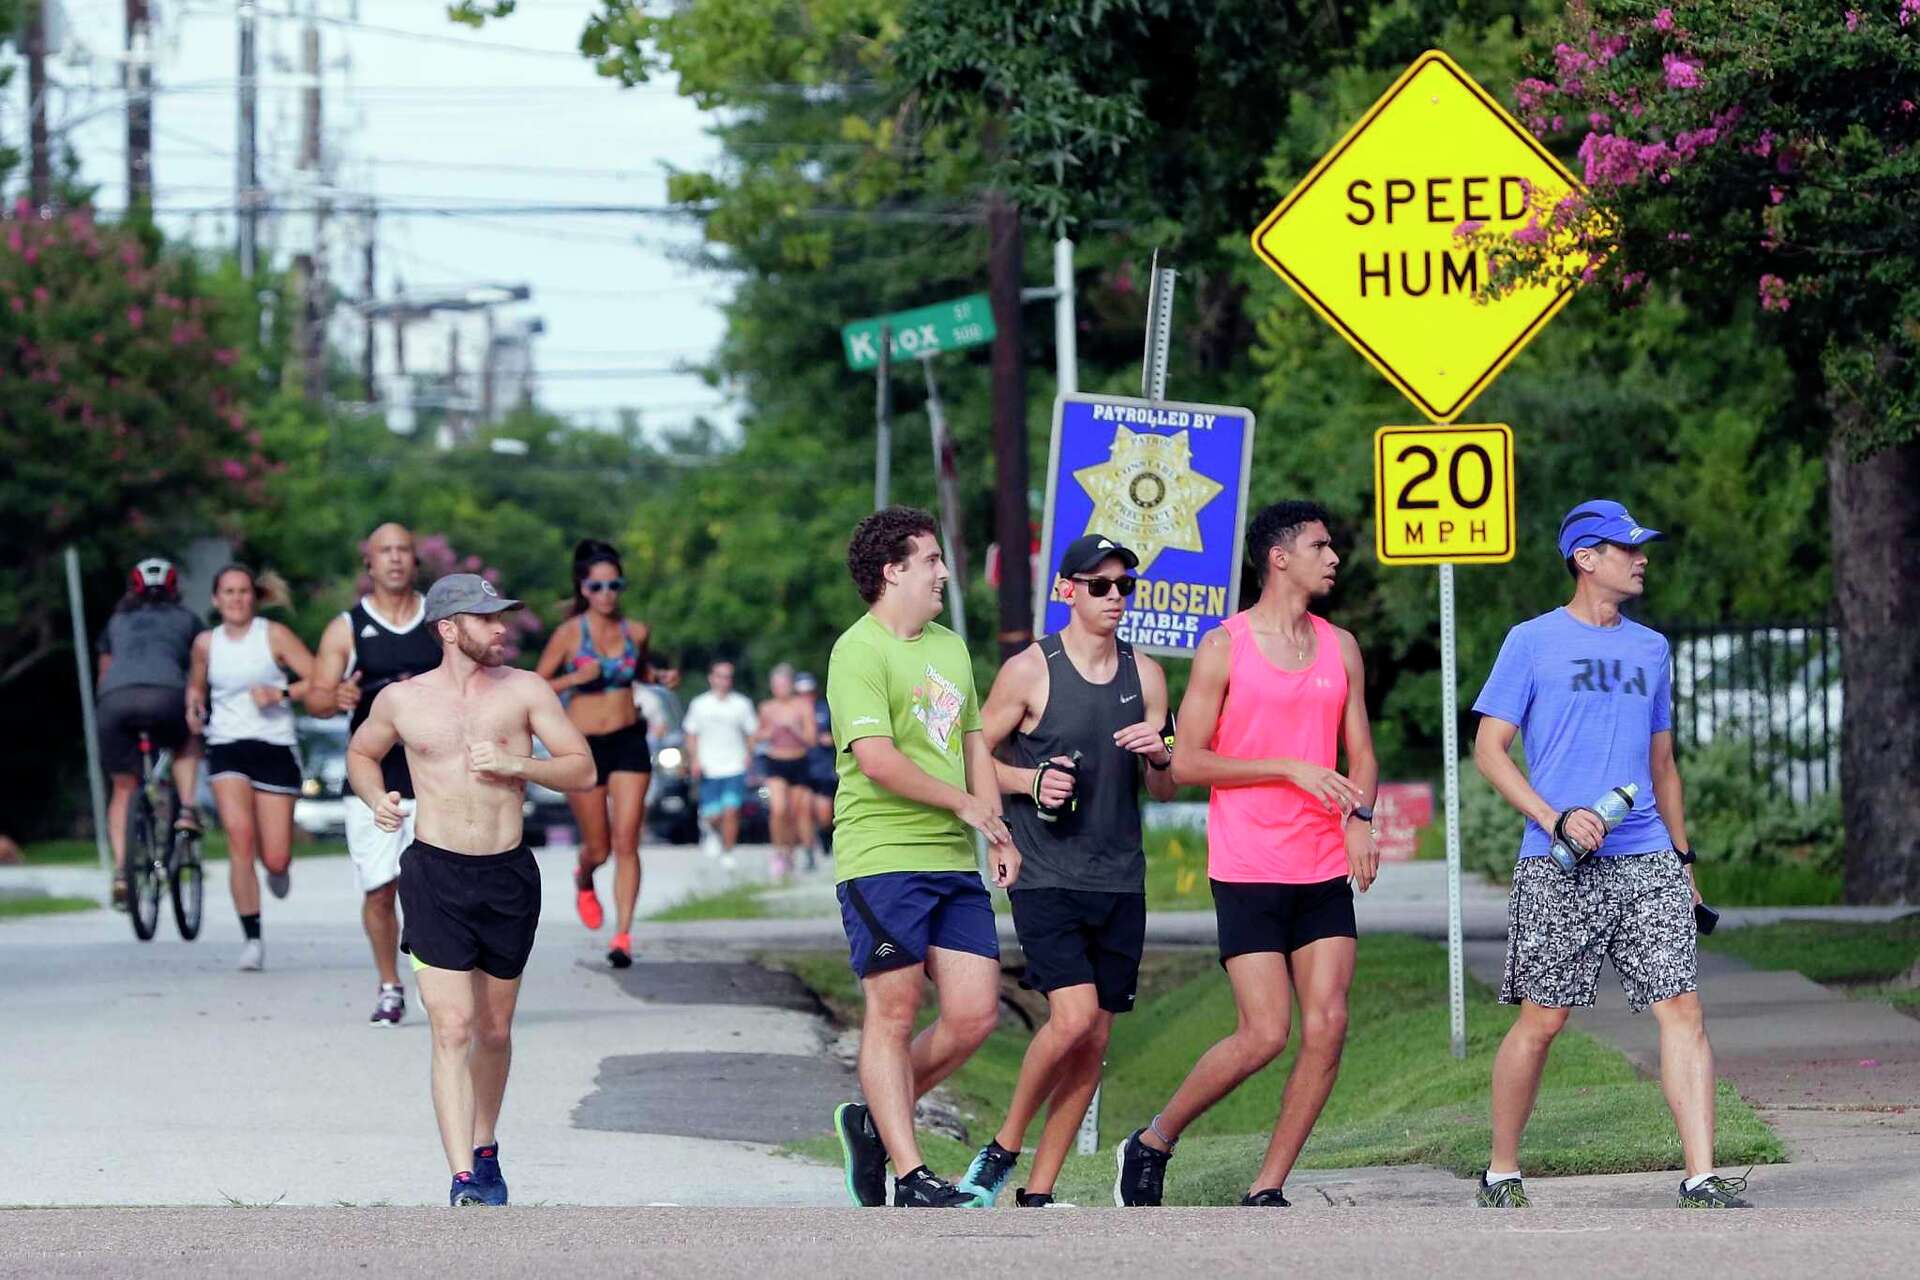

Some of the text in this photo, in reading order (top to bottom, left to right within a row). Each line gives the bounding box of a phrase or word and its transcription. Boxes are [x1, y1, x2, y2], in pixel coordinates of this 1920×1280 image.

[1346, 175, 1531, 226] SPEED
[1360, 250, 1478, 298] HUM
[1092, 404, 1216, 430] PATROLLED BY
[1397, 444, 1493, 509] 20
[1405, 520, 1486, 544] MPH
[1133, 578, 1227, 616] ROSEN
[1117, 625, 1181, 647] CINCT
[1119, 610, 1199, 632] STABLE
